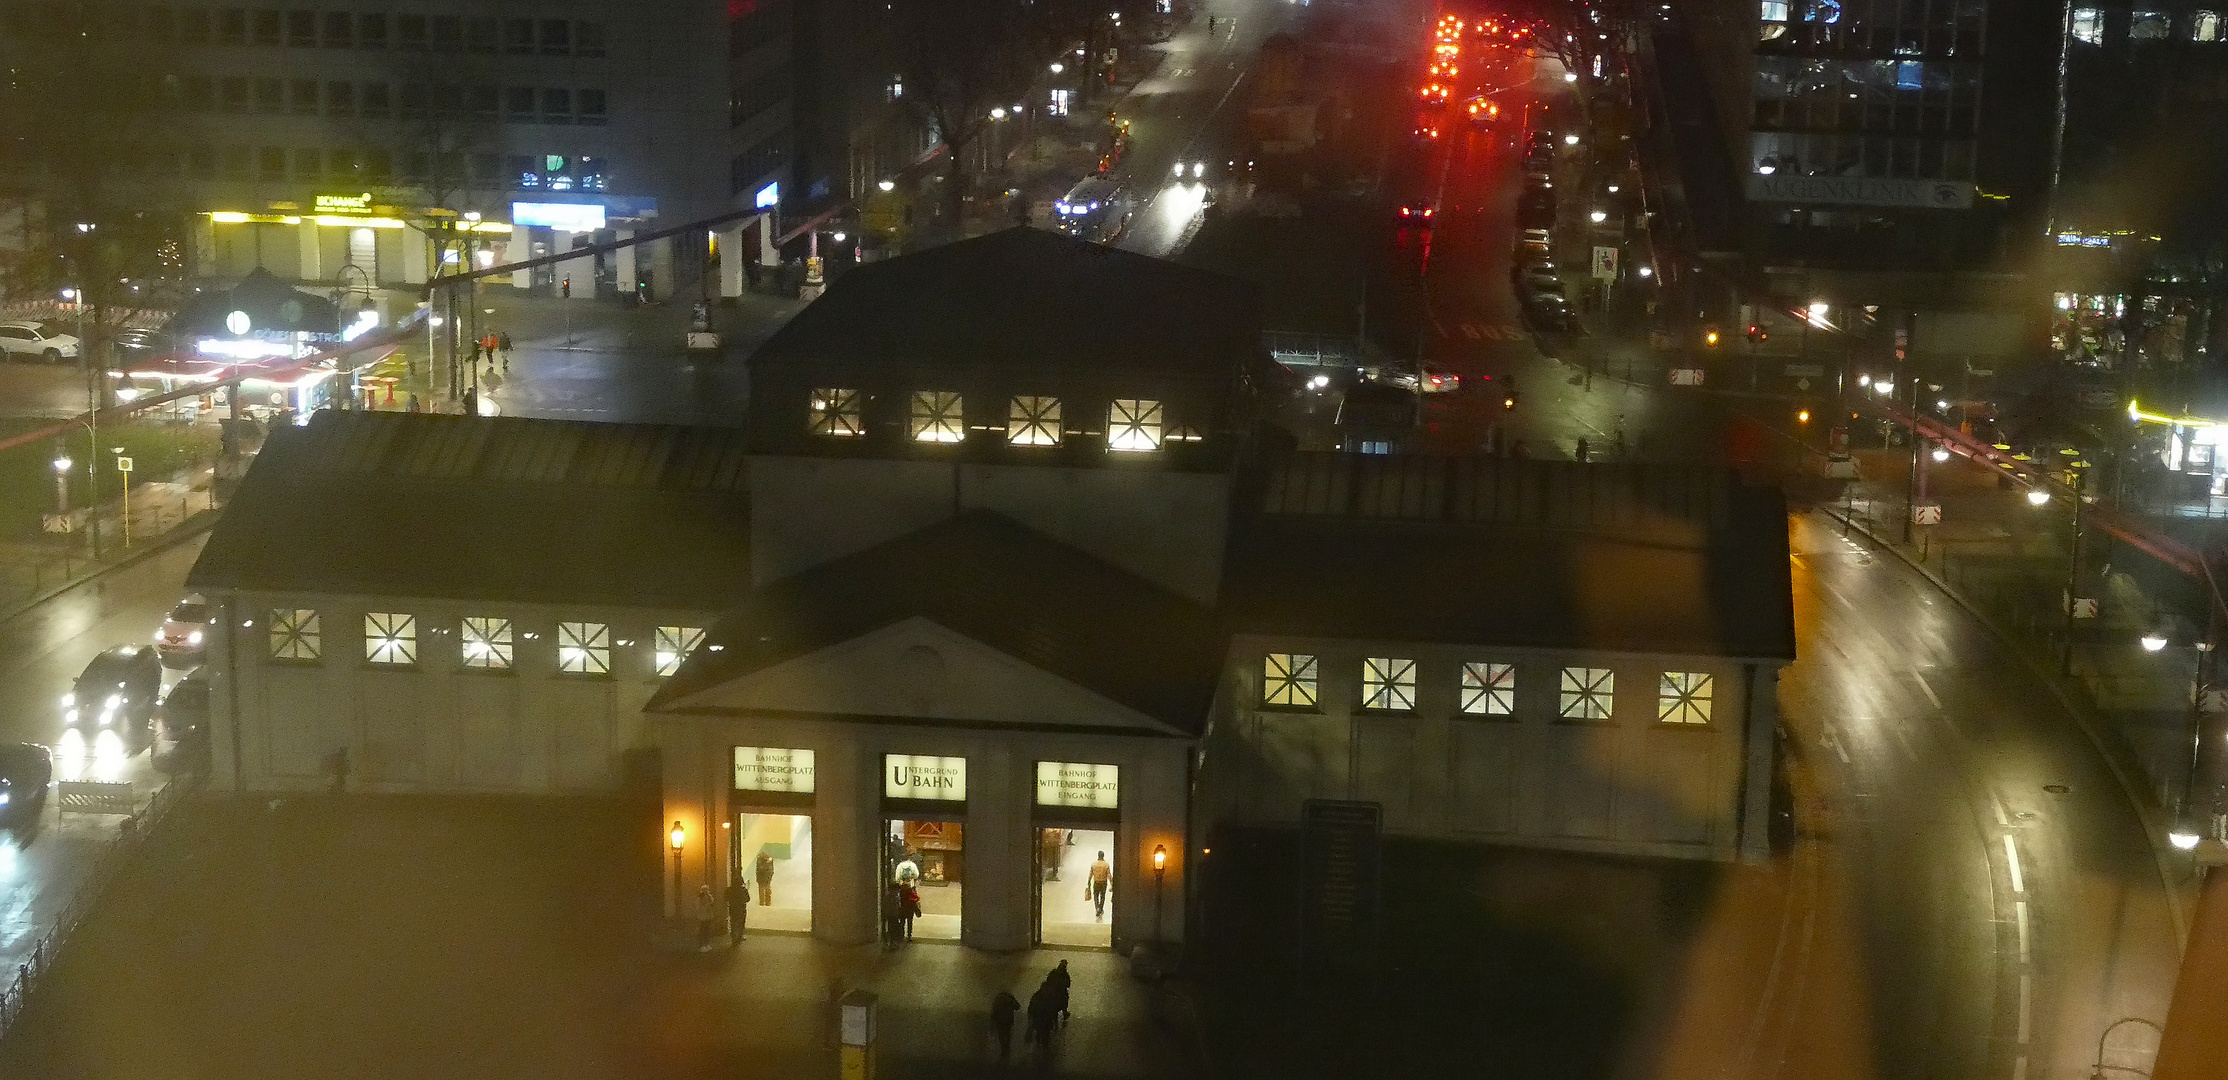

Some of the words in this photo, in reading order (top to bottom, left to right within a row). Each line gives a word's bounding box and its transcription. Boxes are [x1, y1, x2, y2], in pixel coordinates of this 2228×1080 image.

[1760, 178, 1918, 201] AUGENKLINIK
[755, 754, 793, 763] BAHNHOF
[736, 763, 813, 775] WITTENBERGPLATZ
[1058, 769, 1097, 778] BAHNHOF
[754, 776, 794, 785] AUSGANG
[912, 775, 954, 788] BAHN
[1039, 779, 1117, 791] WITTENBERGPLATZ
[1058, 791, 1097, 800] EINGANG
